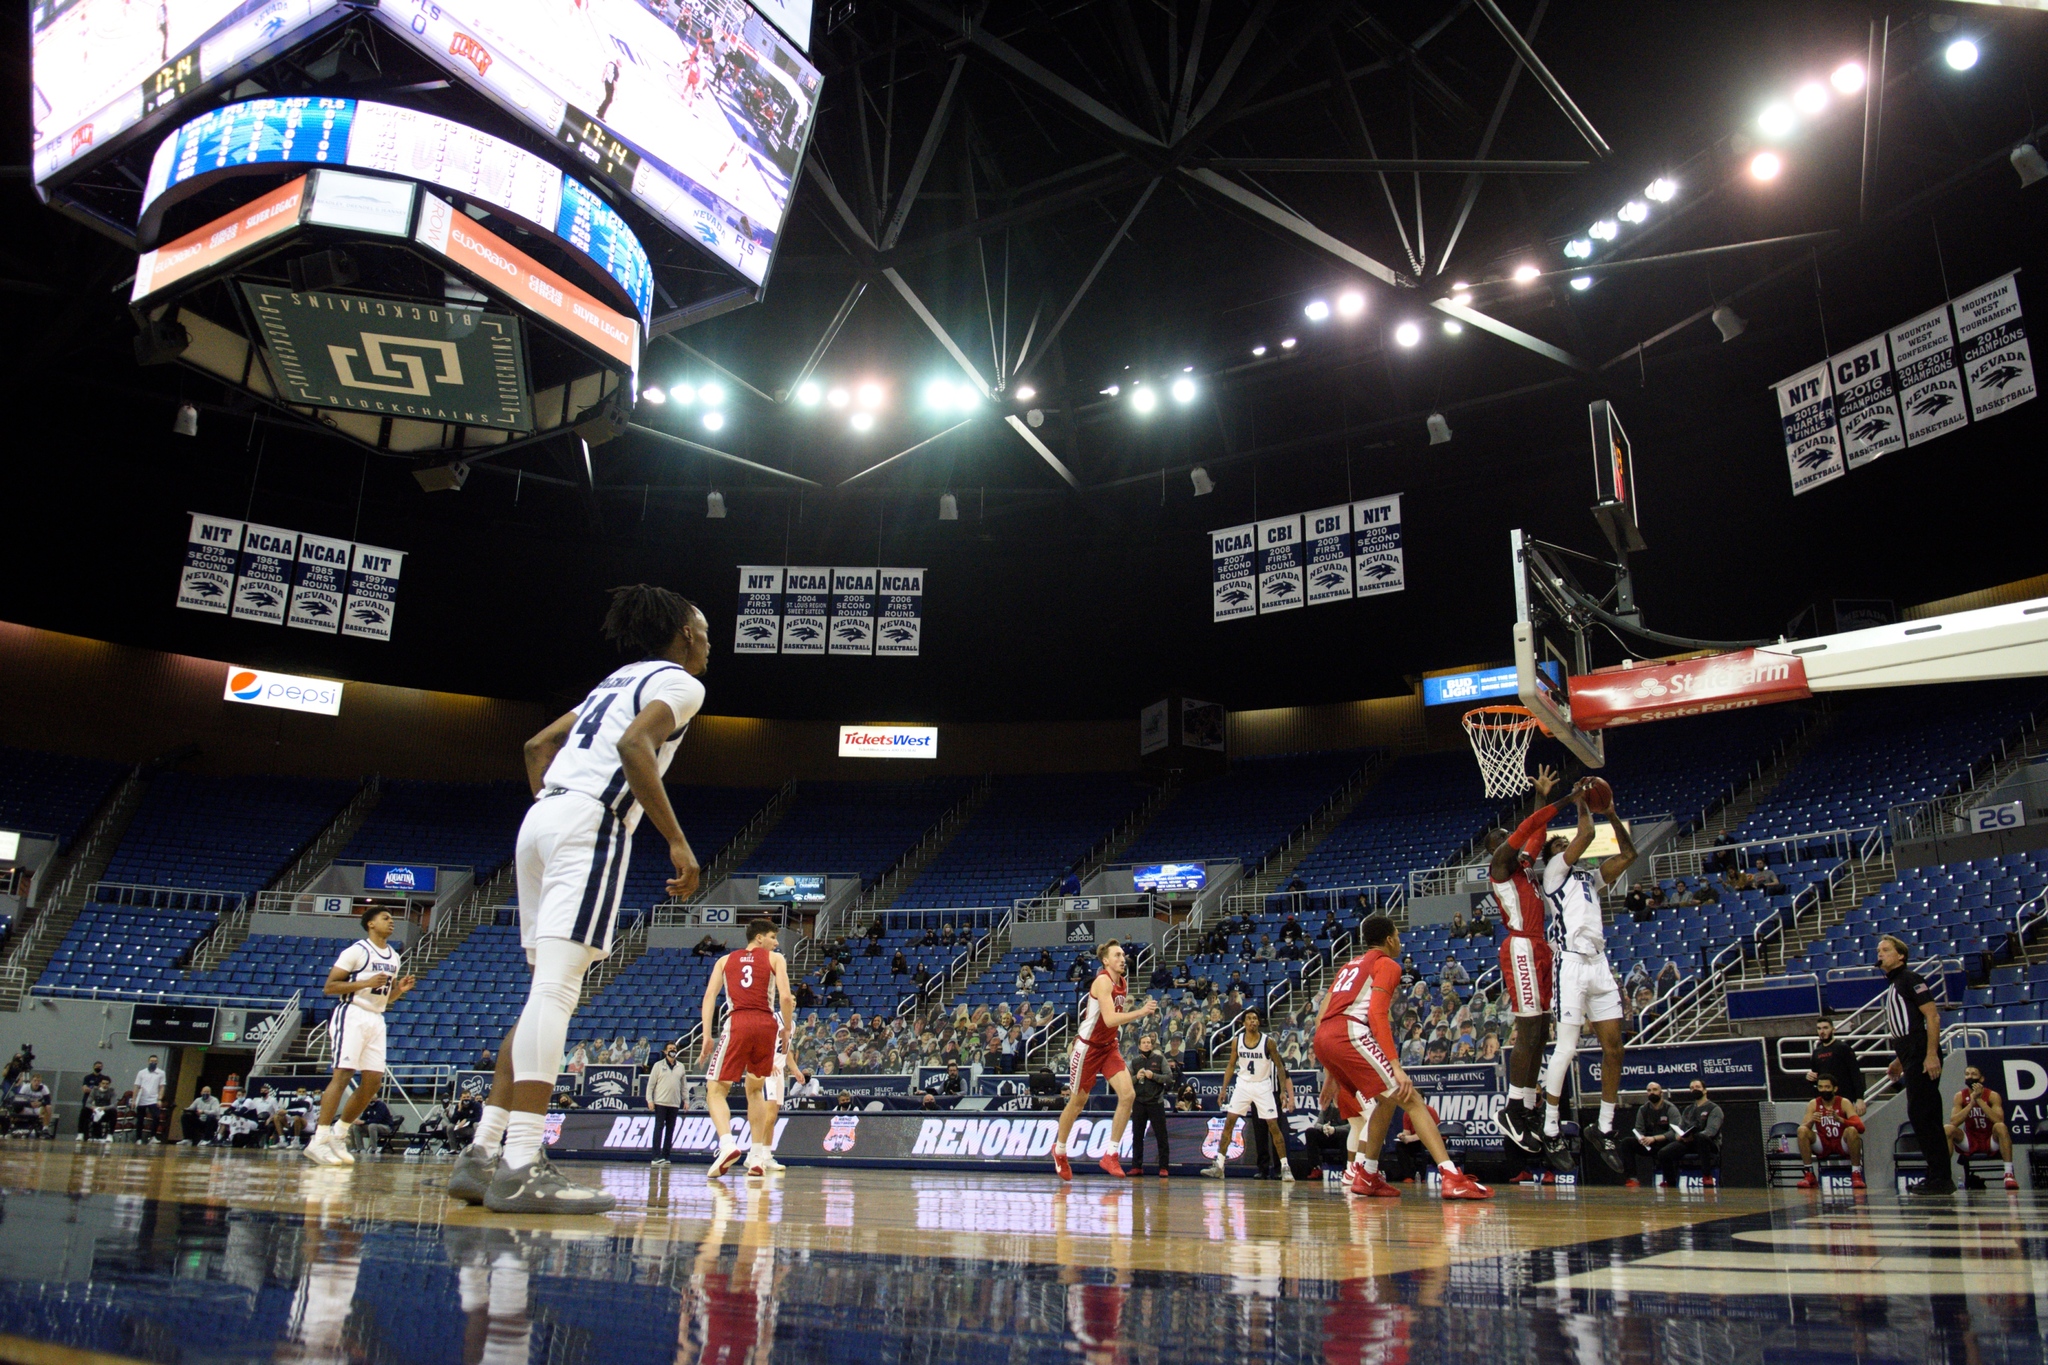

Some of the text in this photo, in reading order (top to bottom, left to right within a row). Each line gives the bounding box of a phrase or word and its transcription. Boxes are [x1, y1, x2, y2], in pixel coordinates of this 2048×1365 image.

[448, 31, 493, 76] UNLV
[284, 98, 345, 109] AST FLS
[582, 121, 629, 165] 17:14
[579, 141, 600, 164] PER
[568, 179, 602, 209] PLAYER
[246, 194, 299, 229] SILVER LEGACY
[692, 209, 726, 239] NEVADA
[733, 234, 755, 256] FLS
[530, 274, 563, 299] CIRCUS
[528, 282, 562, 308] CIRCUS
[1961, 286, 2008, 313] MOUNTAIN
[1974, 301, 1999, 317] WEST
[573, 303, 629, 345] SILVER LEGACY
[1960, 304, 2018, 334] TOURNAMENT
[1897, 317, 1941, 342] MOUNTAIN
[1977, 326, 2006, 346] 2017
[1908, 332, 1932, 347] WEST
[1964, 328, 2024, 361] CHAMPIONS
[1897, 334, 1948, 362] CONFERENCE
[1838, 349, 1881, 385] CBI
[1899, 348, 1953, 379] 2016-2017
[1970, 351, 2026, 383] NEVADA
[1902, 360, 1953, 388] CHAMPIONS
[1789, 378, 1820, 407] NIT
[1844, 377, 1883, 403] 2016
[1905, 380, 1957, 410] NEVADA
[1840, 386, 1892, 416] CHAMPIONS
[1975, 386, 2034, 414] BASKETBALL
[330, 395, 488, 423] BLOCKCHAINS
[1794, 404, 1819, 422] 2012
[1786, 408, 1833, 435] QUARTER
[1845, 405, 1894, 435] NEVADA
[1794, 421, 1827, 441] FINALS
[1909, 414, 1965, 441] BASKETBALL
[1791, 435, 1837, 463] NEVADA
[1849, 435, 1900, 461] BASKETBALL
[1794, 464, 1841, 489] BASKETBALL
[1363, 505, 1391, 524] NIT
[1316, 516, 1340, 534] CBI
[1366, 527, 1387, 537] 2010
[201, 524, 232, 543] NIT
[1268, 525, 1292, 543] CBI
[1357, 533, 1400, 547] SECOND
[248, 533, 292, 555] NCAA
[1215, 534, 1252, 554] NCAA
[1316, 544, 1341, 554] FIRST
[1317, 537, 1339, 547] 2009
[1362, 542, 1395, 554] ROUND
[202, 546, 225, 555] 1979
[302, 543, 346, 564] NCAA
[1269, 546, 1290, 556] 2008
[1313, 551, 1344, 563] ROUND
[188, 551, 235, 565] SECOND
[256, 556, 279, 565] 1984
[362, 554, 392, 572] NIT
[1224, 555, 1244, 564] 2007
[1268, 553, 1293, 563] FIRST
[1359, 554, 1400, 570] NEVADA
[192, 560, 228, 572] ROUND
[251, 563, 282, 574] FIRST
[311, 566, 333, 575] 1985
[1218, 561, 1251, 573] SECOND
[1265, 560, 1296, 571] ROUND
[1310, 563, 1348, 579] NEVADA
[185, 572, 230, 588] NEVADA
[247, 570, 283, 582] ROUND
[306, 573, 335, 582] FIRST
[365, 575, 386, 584] 1997
[748, 575, 774, 588] NIT
[1220, 569, 1249, 580] ROUND
[1262, 572, 1300, 587] NEVADA
[239, 582, 284, 598] NEVADA
[302, 580, 337, 591] ROUND
[352, 580, 396, 593] SECOND
[789, 576, 827, 590] NCAA
[835, 576, 873, 590] NCAA
[882, 577, 920, 591] NCAA
[1216, 581, 1252, 596] NEVADA
[1359, 580, 1402, 592] BASKETBALL
[295, 591, 338, 608] NEVADA
[355, 589, 389, 600] ROUND
[1309, 589, 1350, 600] BASKETBALL
[180, 596, 227, 609] BASKETBALL
[349, 600, 391, 616] NEVADA
[1262, 597, 1301, 609] BASKETBALL
[235, 606, 282, 619] BASKETBALL
[290, 616, 336, 628] BASKETBALL
[739, 617, 776, 629] NEVADA
[786, 618, 824, 629] NEVADA
[833, 619, 871, 630] NEVADA
[880, 620, 918, 632] NEVADA
[344, 624, 388, 636] BASKETBALL
[1447, 678, 1472, 689] BUD
[267, 683, 336, 704] pepsi
[1443, 686, 1478, 698] LIGHT
[577, 693, 618, 749] 14
[845, 732, 931, 746] TicketsWest
[1980, 806, 2016, 829] 26
[384, 871, 415, 885] AQUAFINA
[324, 899, 341, 911] 18
[1073, 900, 1090, 909] 22
[706, 910, 729, 921] 20
[1067, 933, 1093, 942] adidas
[741, 965, 752, 988] 3
[1332, 967, 1359, 992] 22
[708, 1034, 727, 1076] REBELS
[1239, 1051, 1263, 1060] NEVADA
[1247, 1062, 1255, 1075] 4
[1658, 1063, 1698, 1074] BANKER
[1703, 1059, 1731, 1067] SELECT
[1724, 1064, 1753, 1073] ESTATE
[588, 1071, 629, 1084] NEVADA
[1448, 1072, 1484, 1081] HEATING
[1436, 1082, 1443, 1091] &
[1974, 1118, 1986, 1128] 15
[1826, 1127, 1839, 1137] 30
